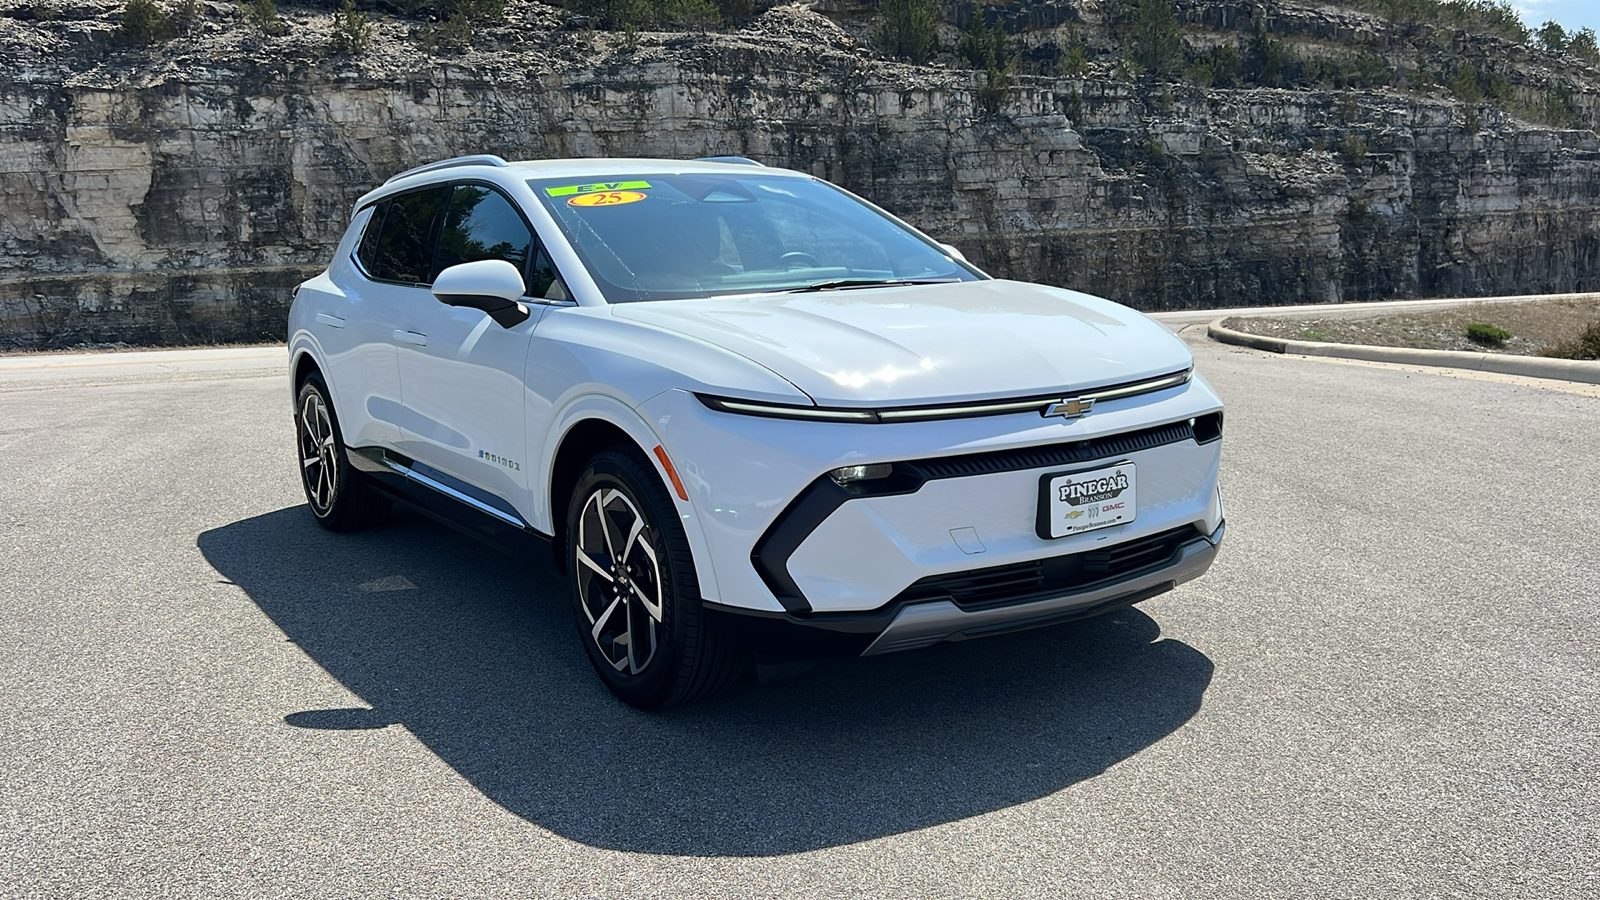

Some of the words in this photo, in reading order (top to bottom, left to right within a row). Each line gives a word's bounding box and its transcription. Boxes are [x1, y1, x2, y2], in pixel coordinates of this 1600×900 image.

[577, 183, 623, 193] E-V
[593, 192, 622, 206] 25
[1059, 474, 1128, 501] PINEGAR
[1079, 492, 1113, 505] BRANSON
[1102, 502, 1125, 513] GMC
